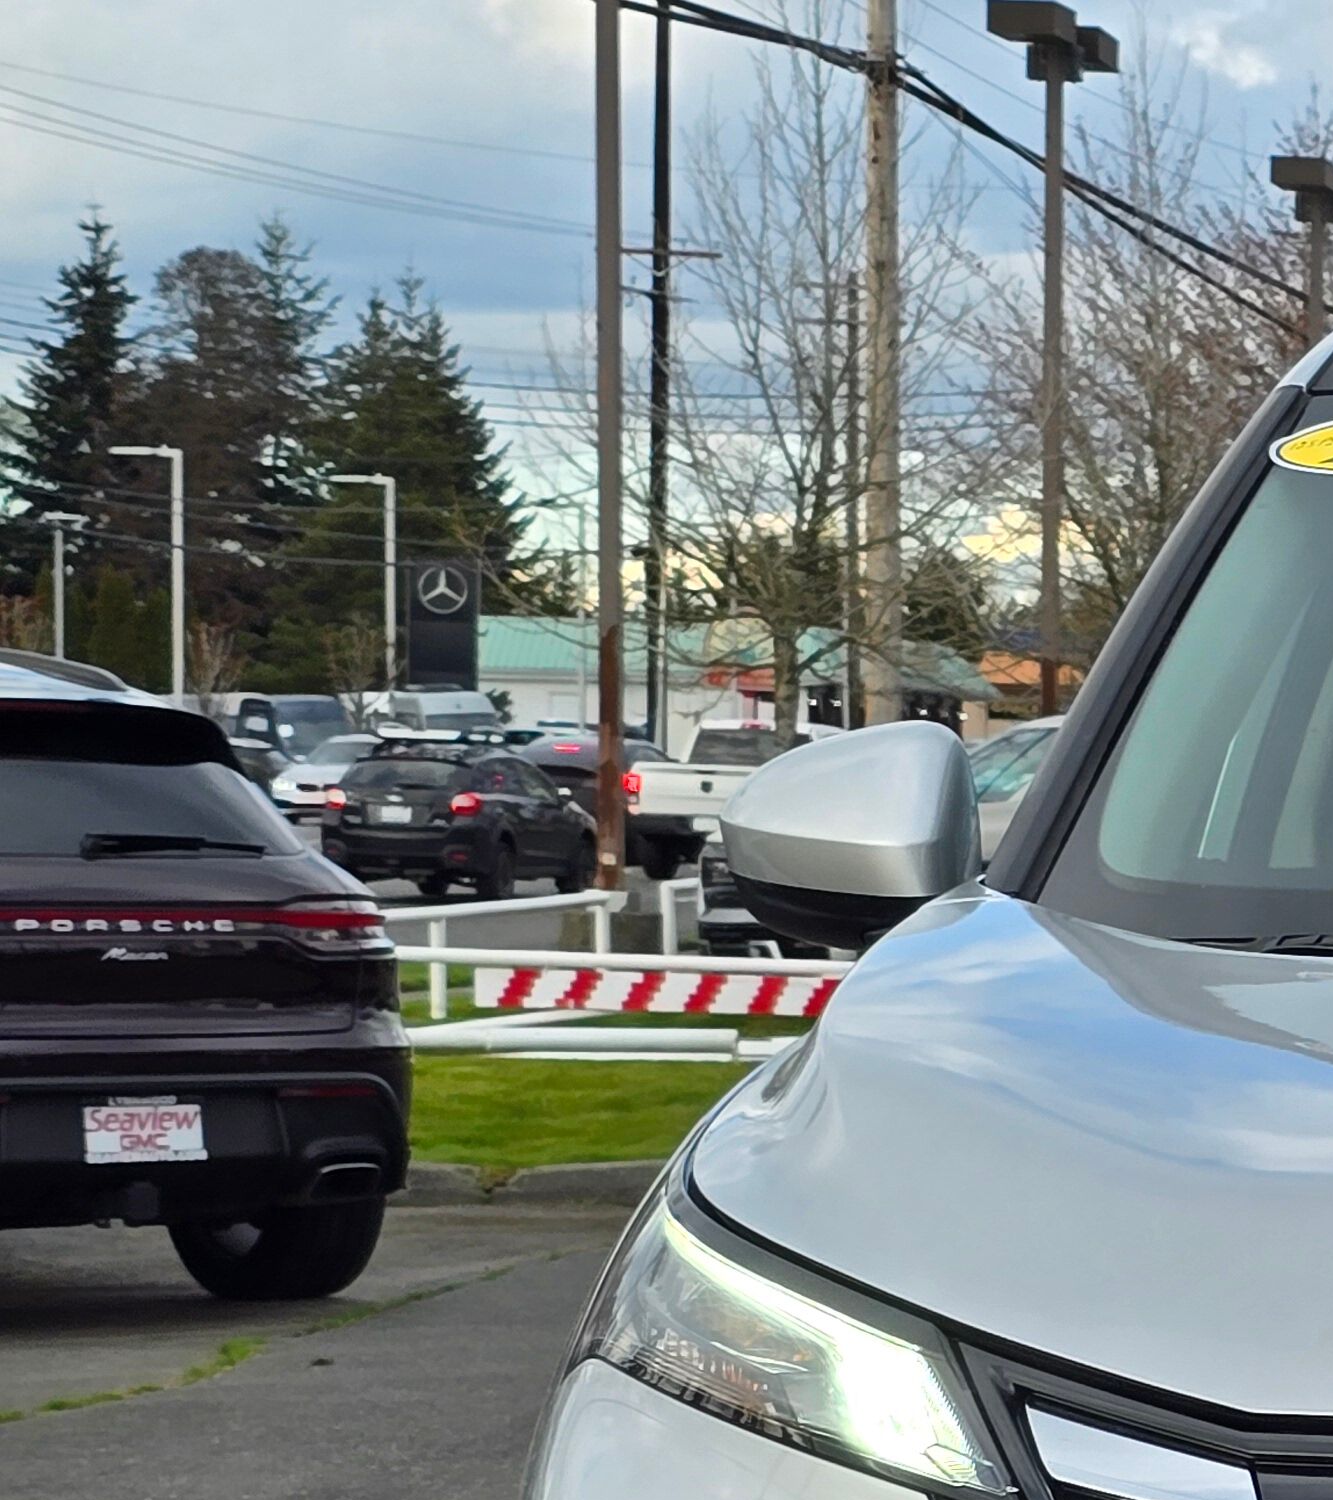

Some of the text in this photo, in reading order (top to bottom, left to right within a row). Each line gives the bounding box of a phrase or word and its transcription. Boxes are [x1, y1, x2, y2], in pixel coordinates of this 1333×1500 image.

[14, 918, 236, 933] PORSCHE
[85, 1107, 199, 1133] Seaview
[120, 1133, 171, 1151] GMC
